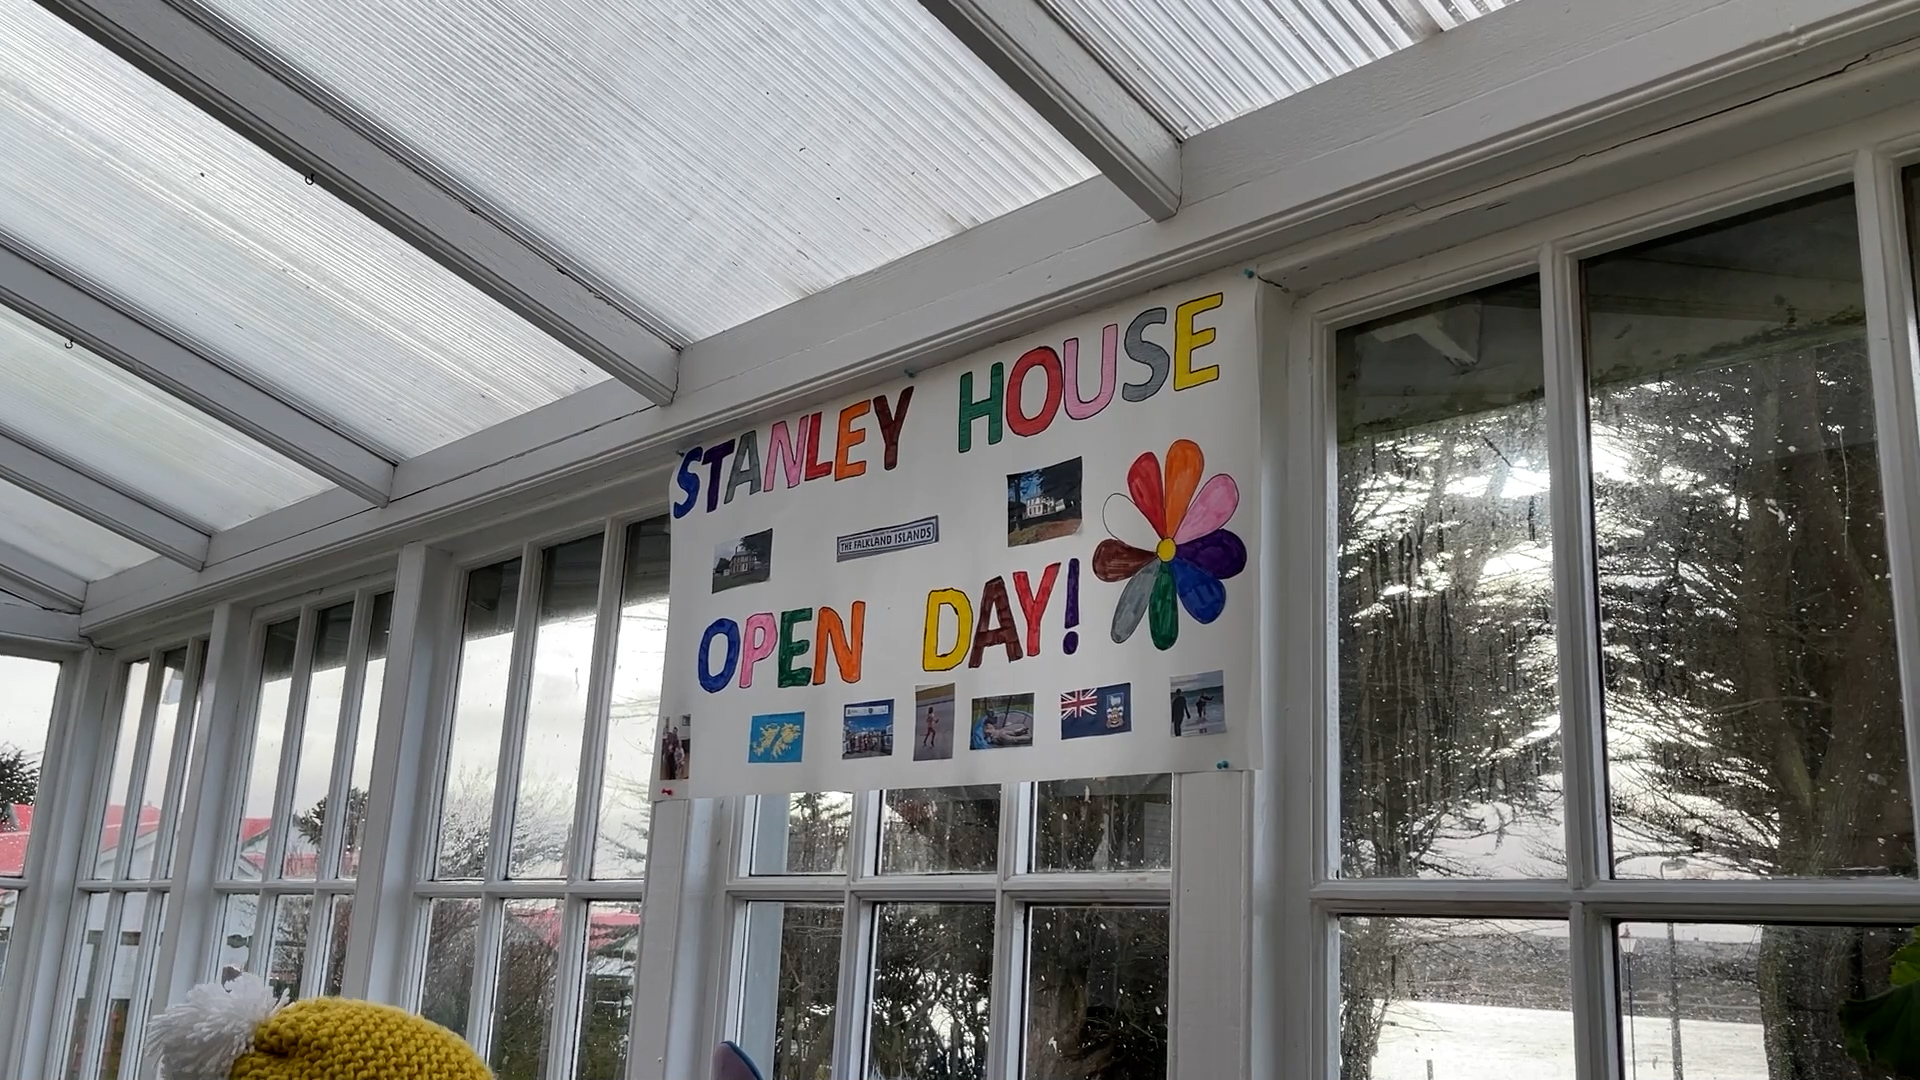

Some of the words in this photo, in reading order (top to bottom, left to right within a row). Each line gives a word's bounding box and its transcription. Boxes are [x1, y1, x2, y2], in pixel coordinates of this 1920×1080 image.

[672, 386, 914, 520] STANLEY
[957, 292, 1224, 454] HOUSE
[840, 540, 852, 552] THE
[853, 535, 892, 550] FALKLAND
[894, 526, 932, 544] ISLANDS
[697, 600, 866, 694] OPEN
[921, 557, 1081, 672] DAY!
